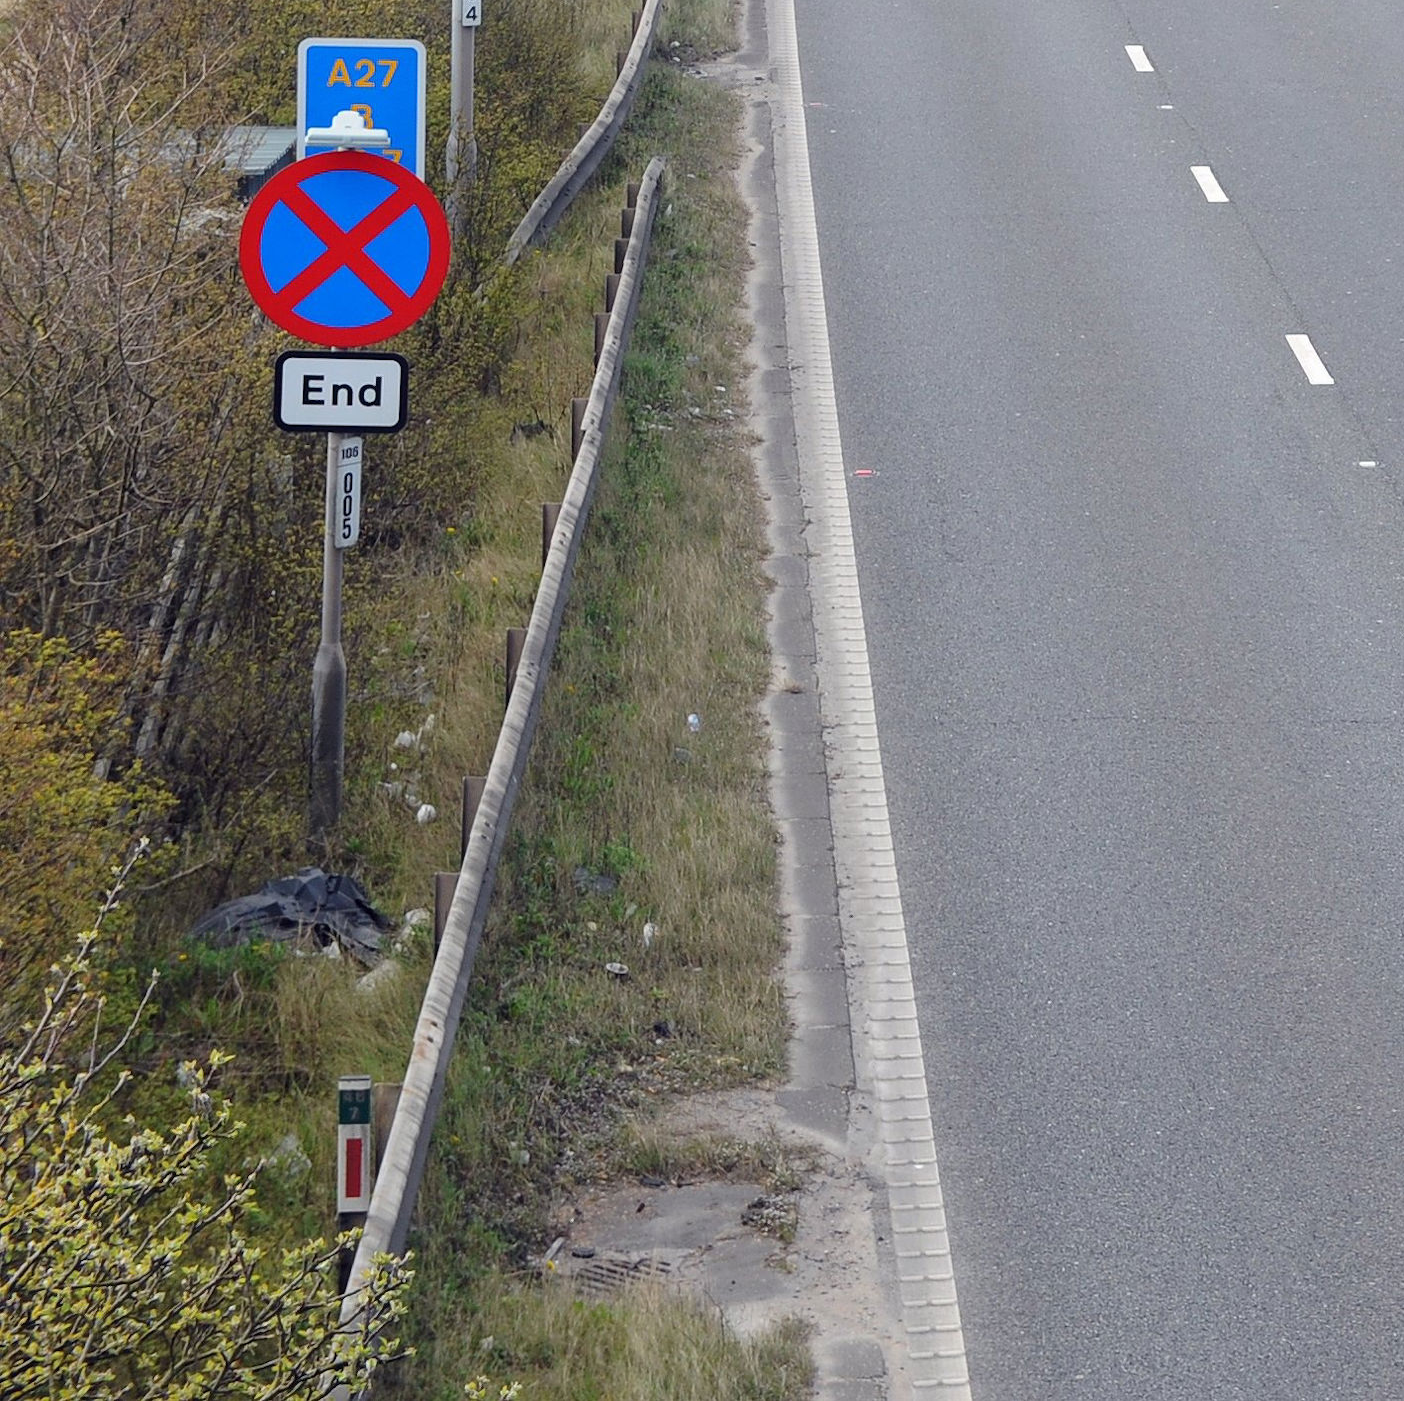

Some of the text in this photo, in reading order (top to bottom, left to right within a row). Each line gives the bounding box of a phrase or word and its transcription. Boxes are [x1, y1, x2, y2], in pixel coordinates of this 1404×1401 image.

[326, 58, 400, 88] A27
[302, 374, 382, 407] End
[340, 445, 360, 460] 106
